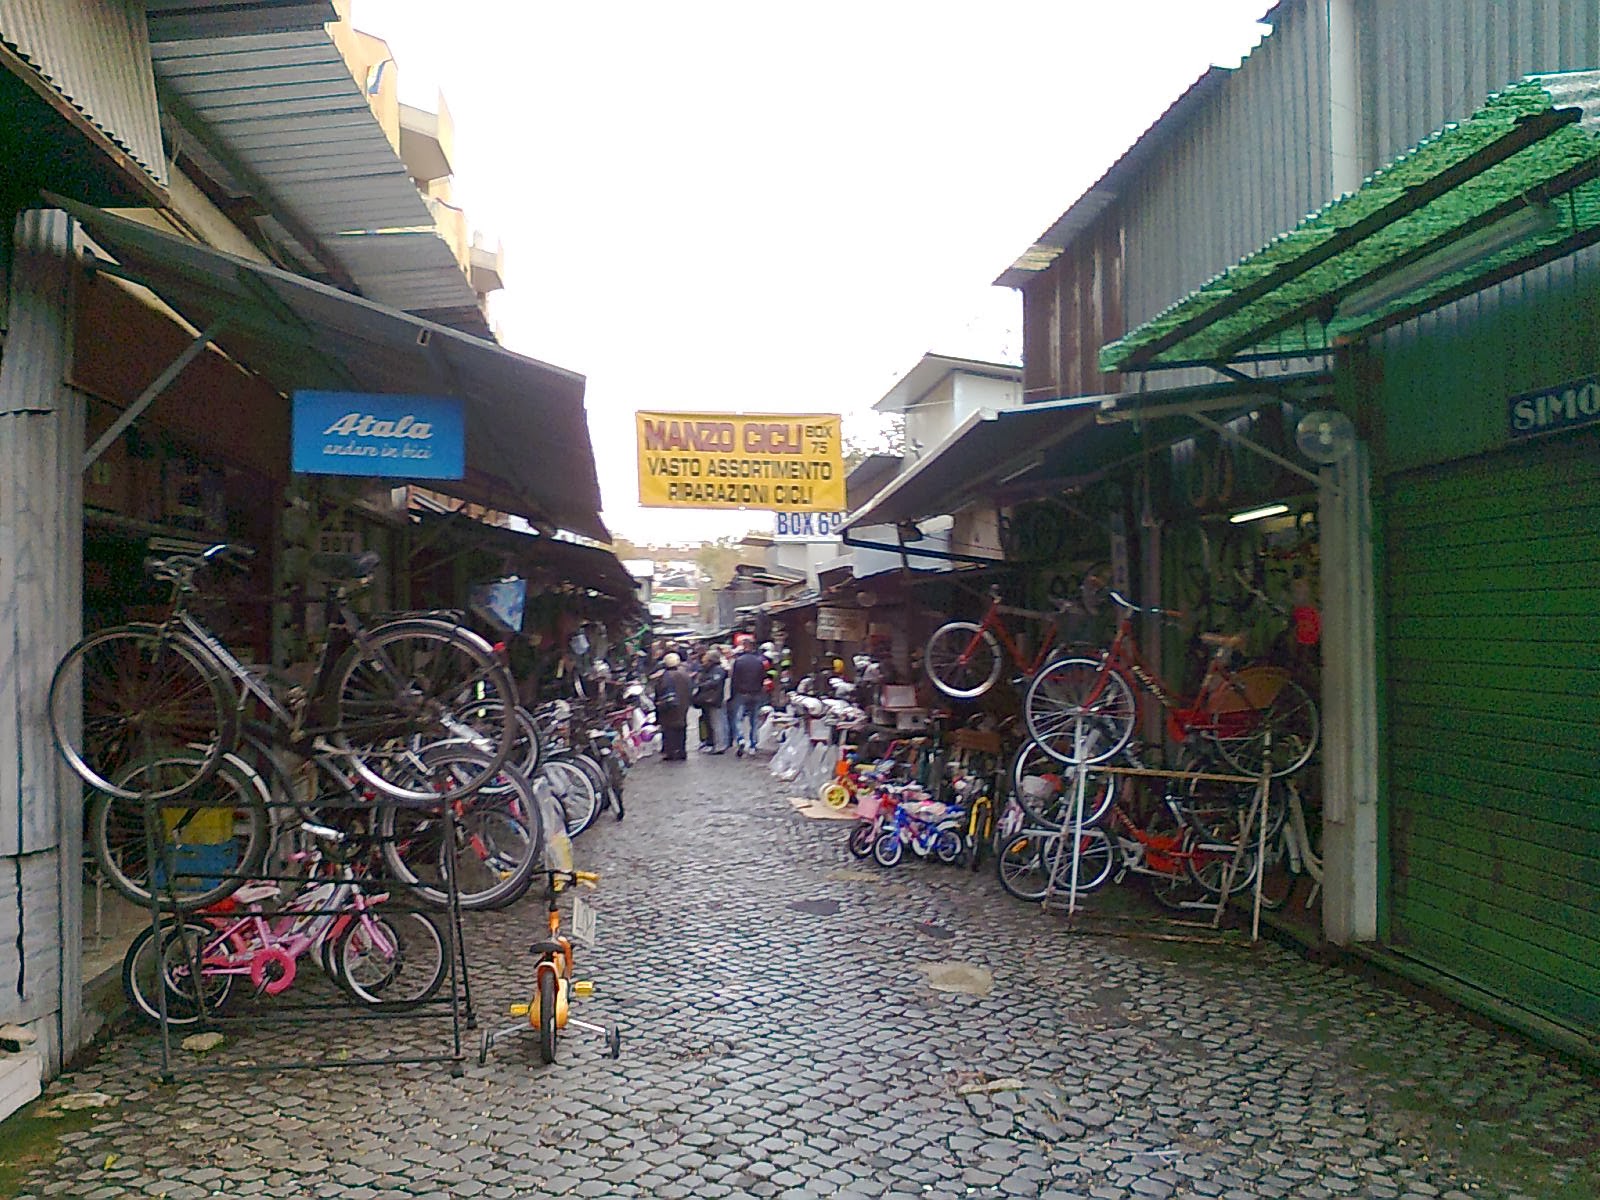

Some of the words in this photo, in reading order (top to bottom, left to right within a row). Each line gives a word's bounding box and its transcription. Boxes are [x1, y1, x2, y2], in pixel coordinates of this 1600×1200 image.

[323, 413, 433, 439] Atala
[644, 419, 735, 452] MANZO
[743, 423, 803, 454] CICLI
[805, 425, 832, 438] BOX
[323, 441, 378, 456] andare
[382, 443, 398, 458] in
[402, 443, 432, 459] bici
[811, 441, 828, 454] 75
[648, 457, 701, 476] VASTO
[707, 459, 833, 480] ASSORTIMENTO
[668, 483, 768, 503] RIPARAZIONI
[774, 485, 813, 504] CICLI
[777, 511, 814, 535] BOX
